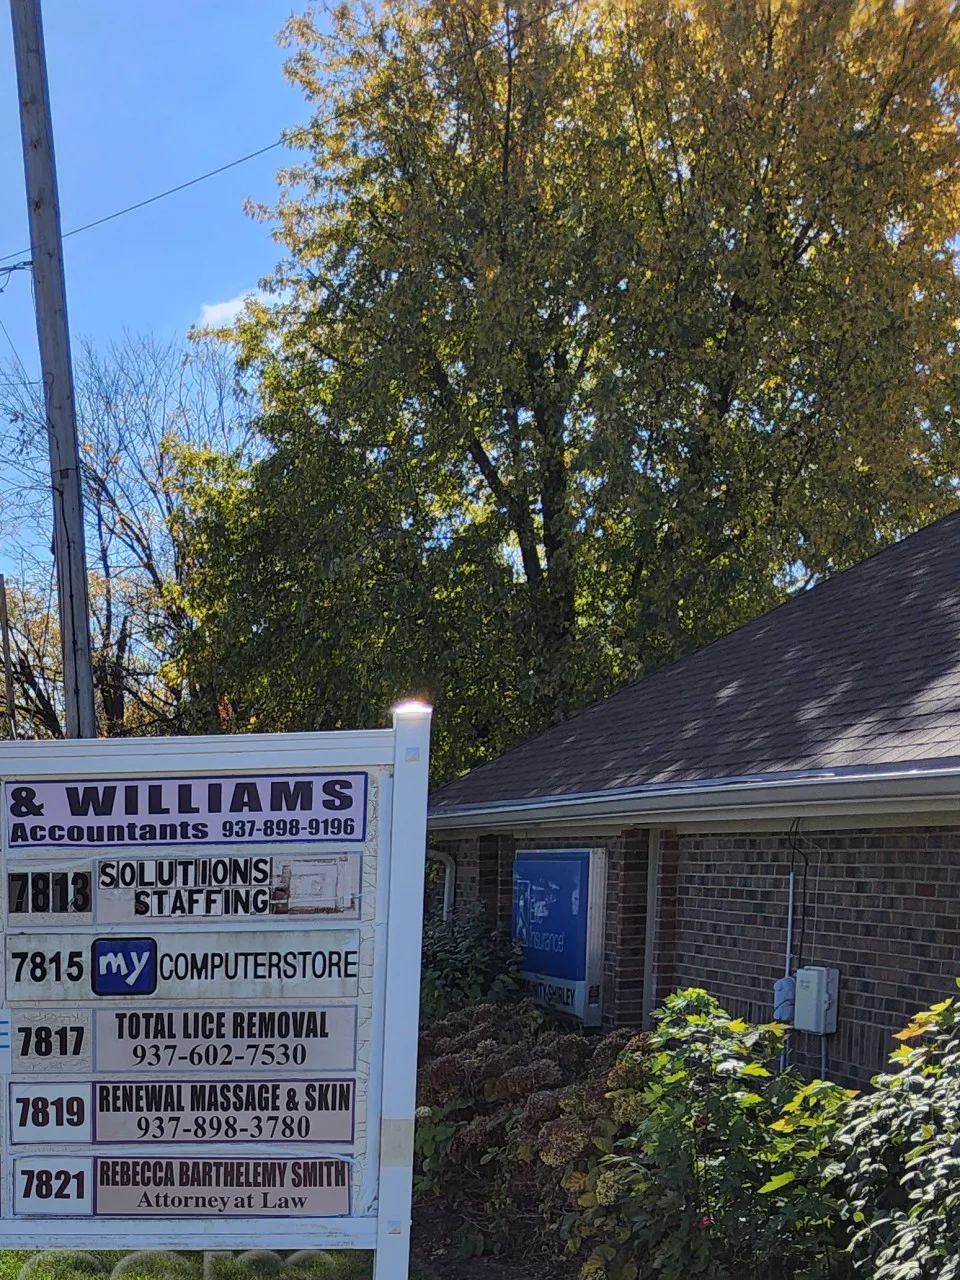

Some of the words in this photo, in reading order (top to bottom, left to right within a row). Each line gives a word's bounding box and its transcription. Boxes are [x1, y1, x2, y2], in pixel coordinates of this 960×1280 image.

[10, 786, 45, 818] &
[65, 779, 353, 817] WILLIAMS
[10, 821, 209, 842] Accountants
[222, 818, 355, 838] 937-898-9196
[100, 858, 269, 887] SOLUTIONS
[11, 872, 90, 912] 7813
[135, 889, 269, 915] STAFFING
[530, 926, 564, 952] Insurance
[11, 951, 84, 982] 7815
[99, 951, 150, 986] my
[160, 951, 358, 980] COMPUTERSTORE
[115, 1012, 176, 1039] TOTAL
[183, 1012, 226, 1039] LICE
[233, 1011, 329, 1039] REMOVAL
[17, 1026, 84, 1057] 7817
[132, 1043, 307, 1067] 937-602-7530
[16, 1096, 85, 1127] 7819
[99, 1085, 185, 1113] RENEWAL
[190, 1084, 280, 1112] MASSAGE
[286, 1088, 300, 1112] &
[305, 1083, 350, 1111] SKIN
[137, 1115, 311, 1139] 937-898-3780
[21, 1170, 85, 1199] 7821
[100, 1161, 175, 1187] REBECCA
[179, 1161, 288, 1187] BARTHELEMY
[291, 1160, 346, 1187] SMITH
[137, 1190, 232, 1212] Attorney
[234, 1192, 255, 1208] at
[261, 1191, 308, 1209] Law
